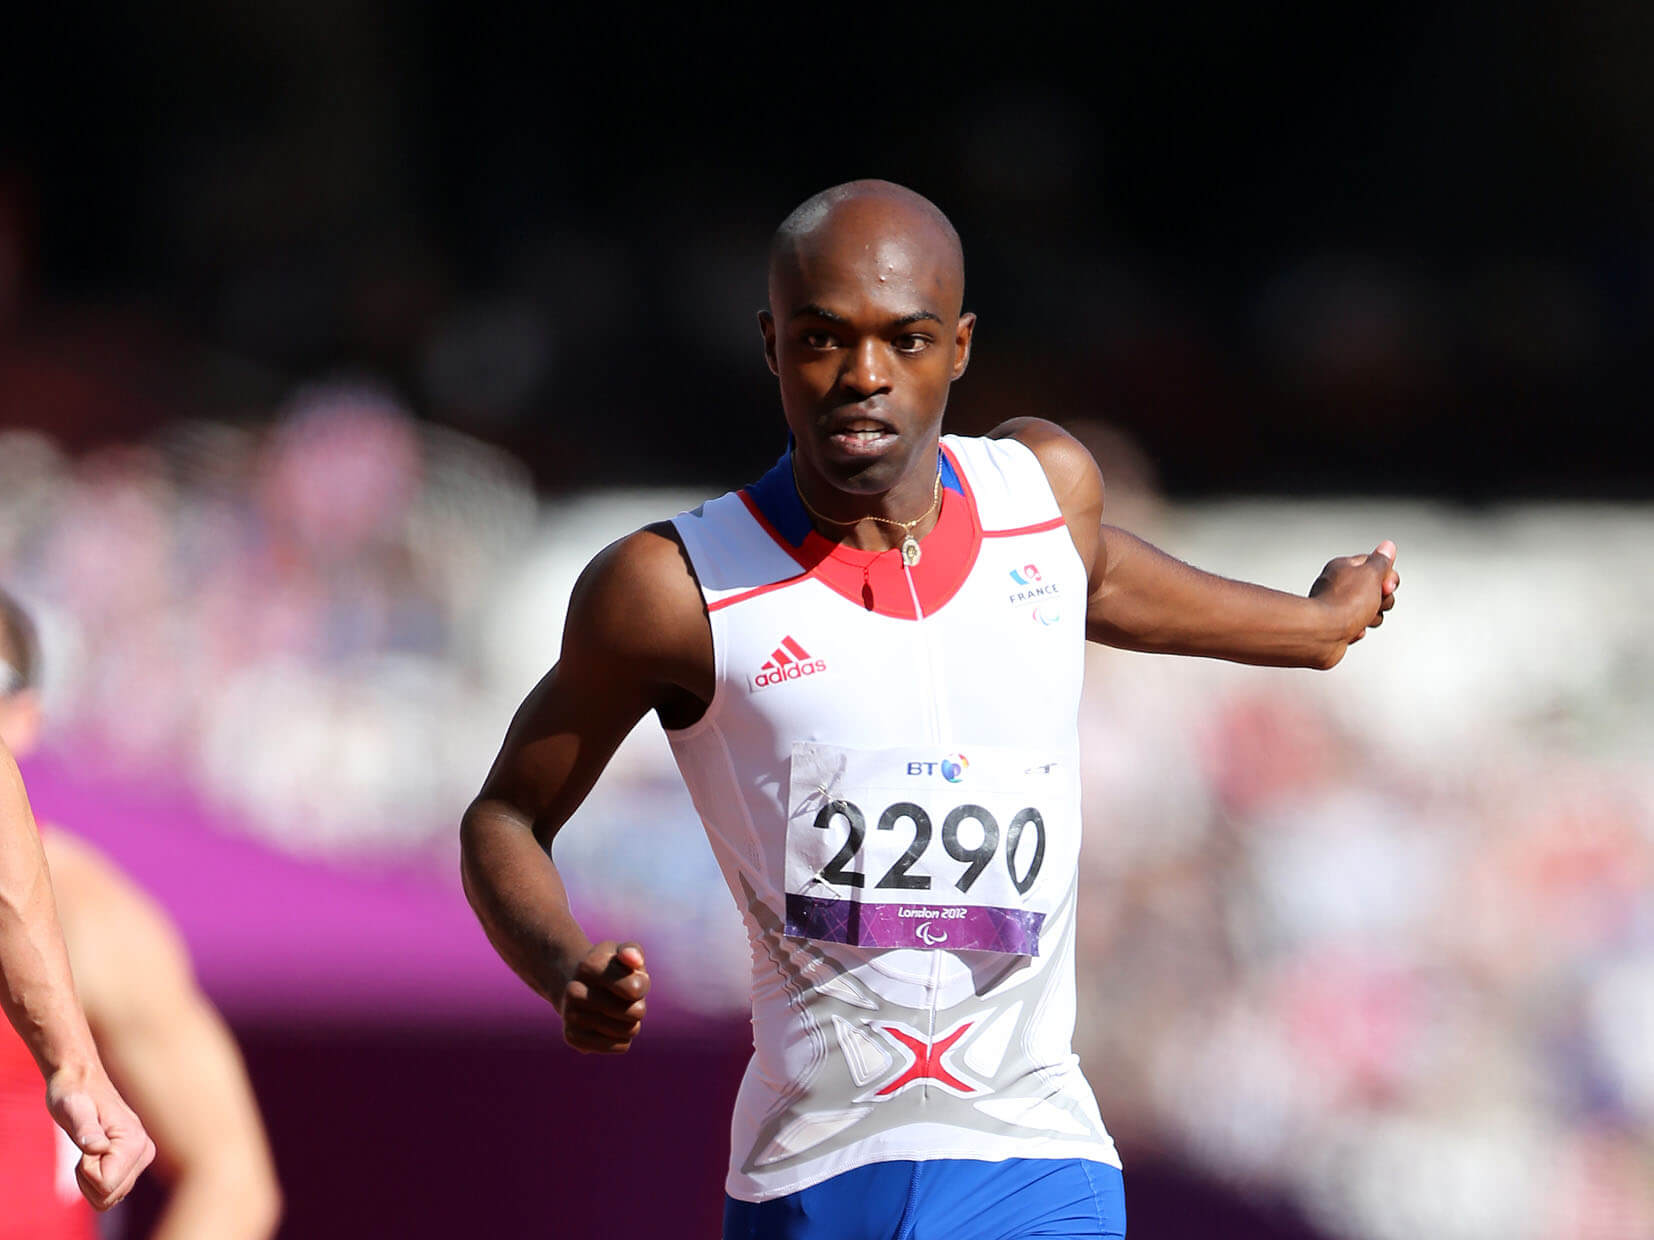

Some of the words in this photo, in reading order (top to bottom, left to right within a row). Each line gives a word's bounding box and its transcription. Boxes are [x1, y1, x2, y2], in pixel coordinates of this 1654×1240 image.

[1009, 583, 1060, 604] FRANCE
[754, 659, 827, 688] adidas
[906, 761, 939, 777] BT
[813, 799, 1046, 896] 2290
[898, 906, 940, 919] London
[941, 907, 968, 919] 2012
